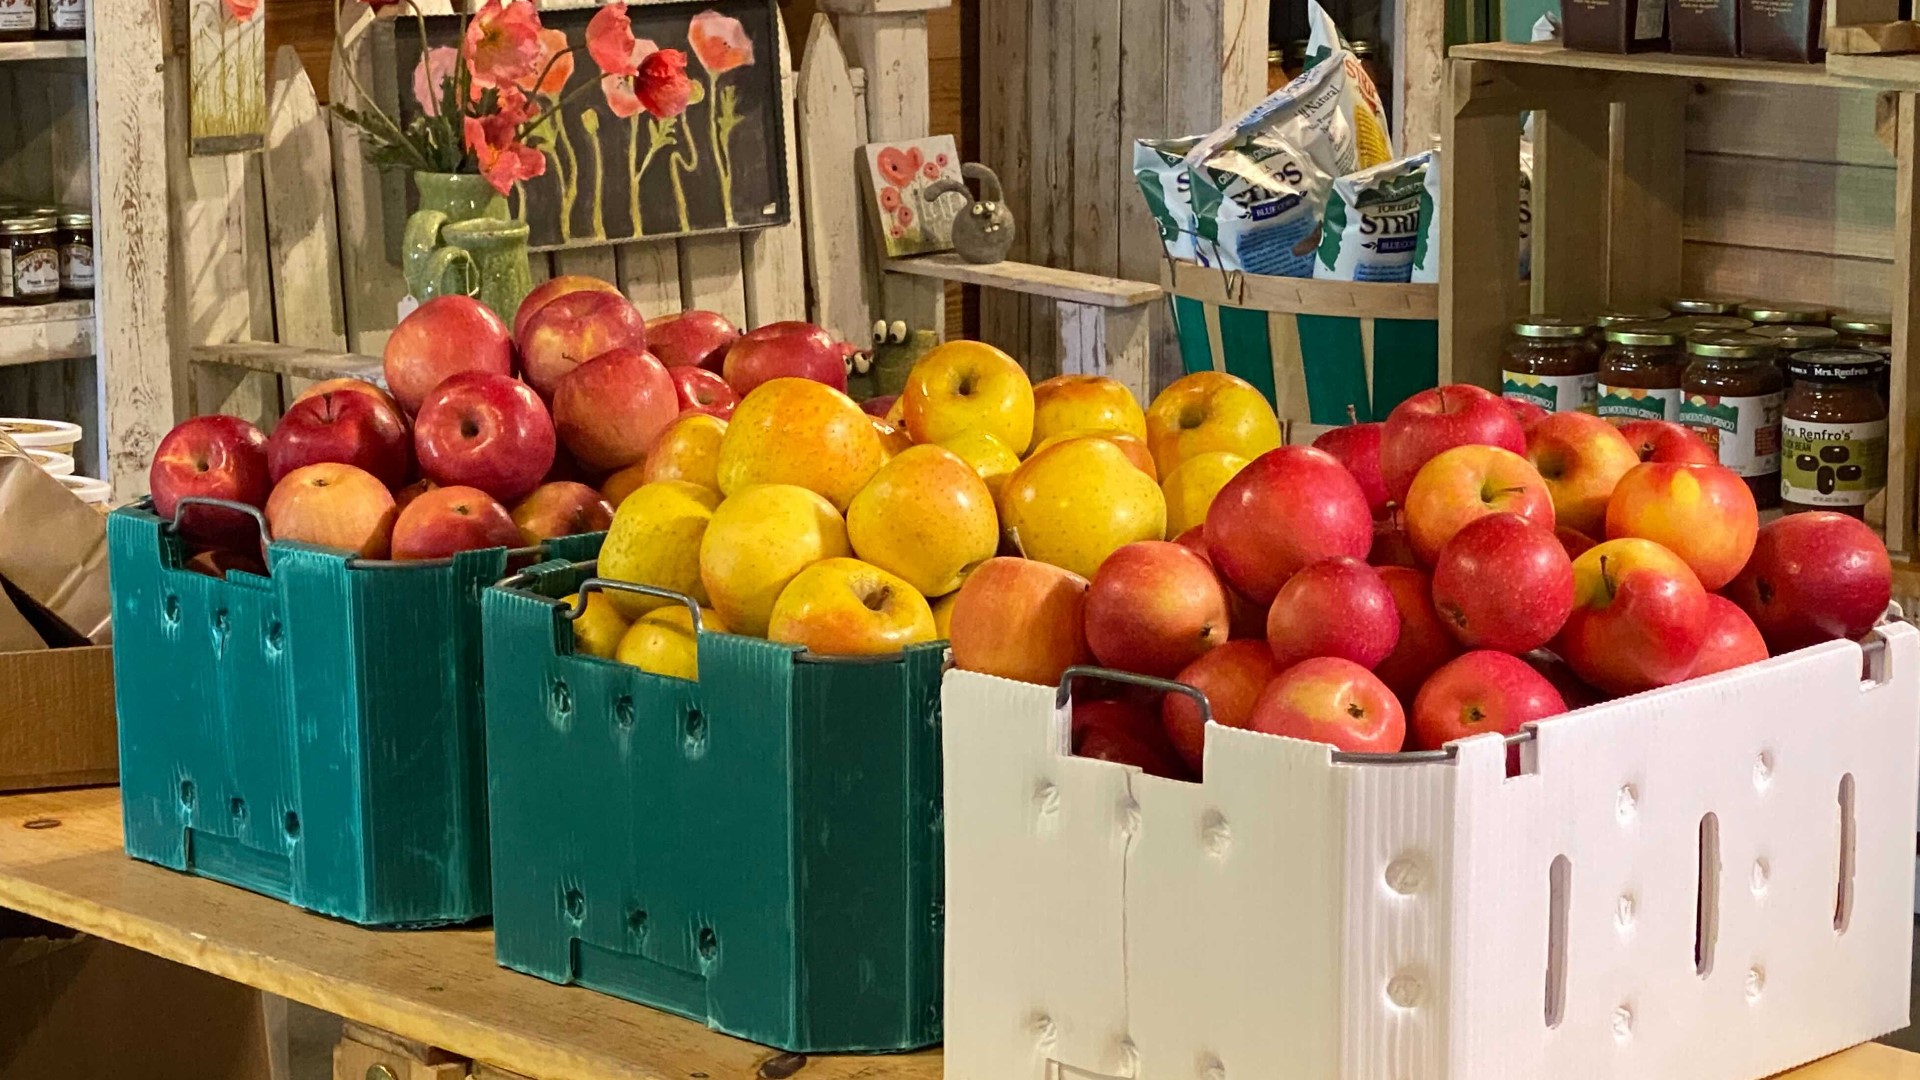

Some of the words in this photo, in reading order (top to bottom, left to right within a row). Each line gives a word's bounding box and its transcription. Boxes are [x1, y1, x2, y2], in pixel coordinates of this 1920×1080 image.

[1304, 84, 1341, 114] Natural
[1230, 161, 1303, 208] STRPS
[1256, 205, 1277, 218] BLUE
[1381, 241, 1400, 250] BLUE
[1609, 405, 1638, 416] MOUNTAIN
[1685, 412, 1712, 424] MOUNTAIN
[1711, 416, 1735, 431] GRINGO
[1799, 427, 1851, 443] Renfro's
